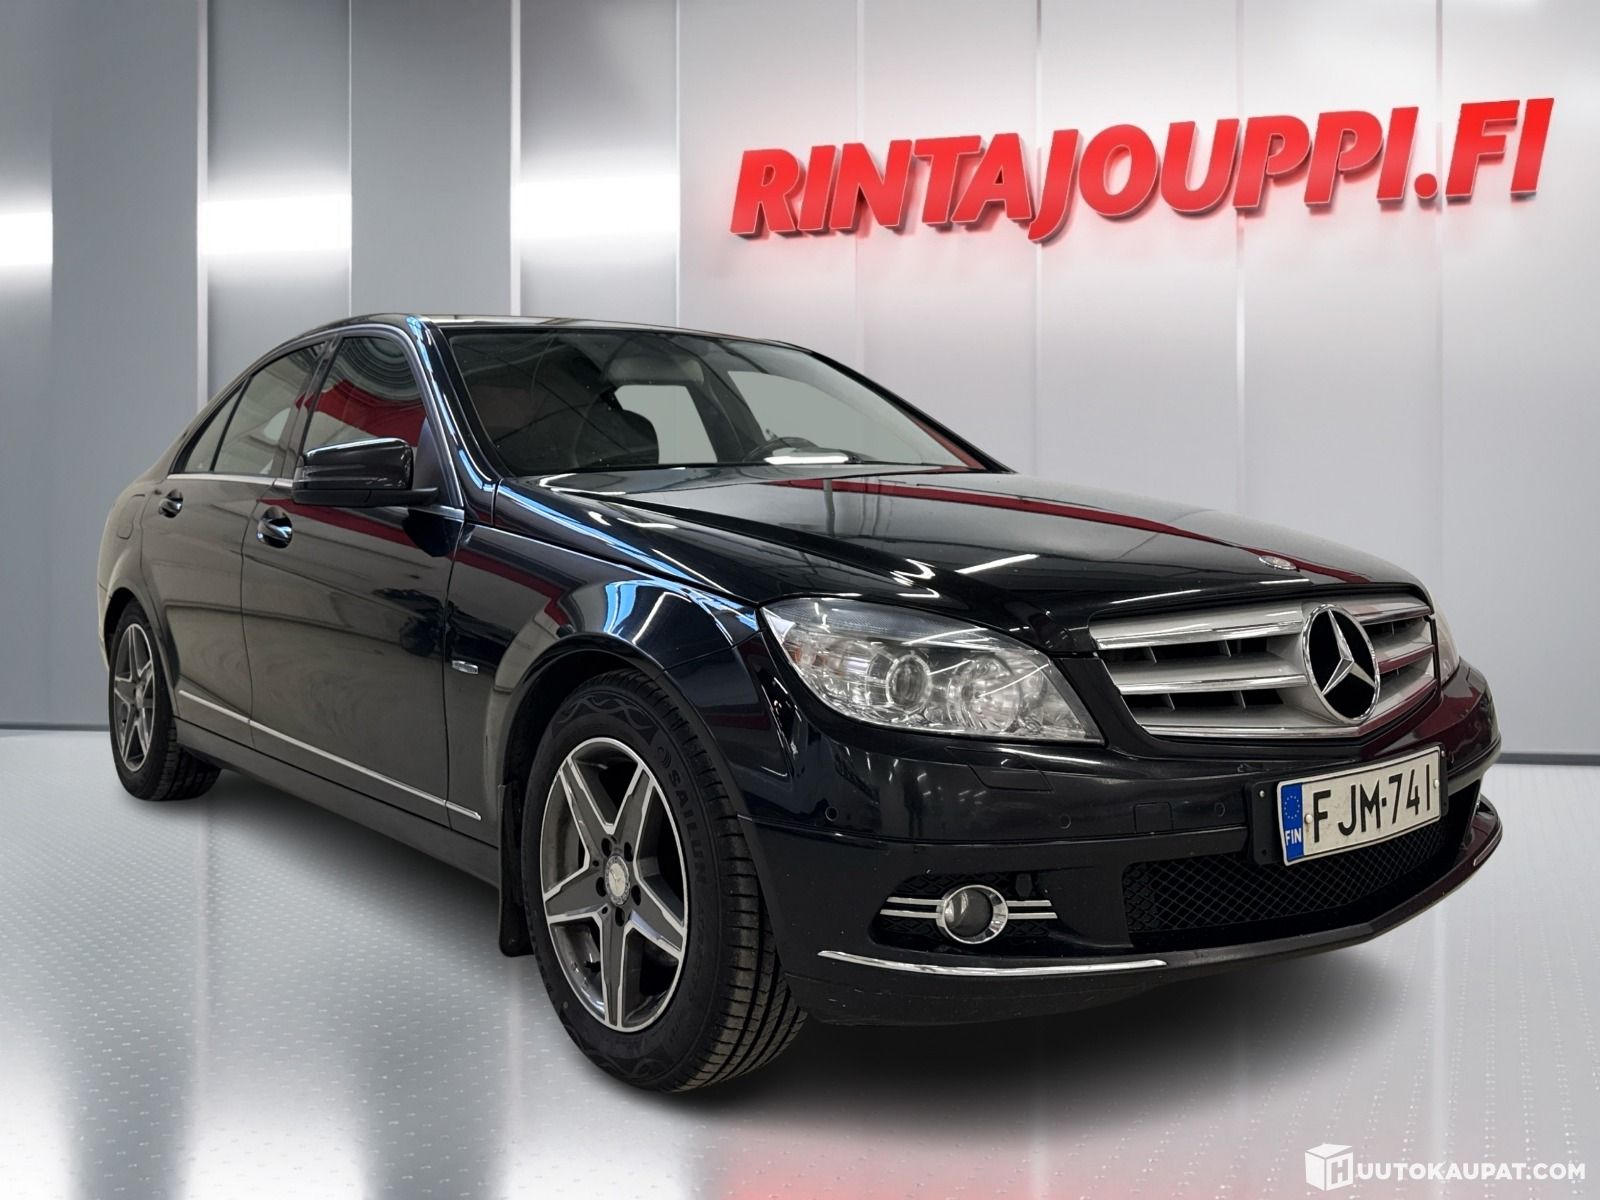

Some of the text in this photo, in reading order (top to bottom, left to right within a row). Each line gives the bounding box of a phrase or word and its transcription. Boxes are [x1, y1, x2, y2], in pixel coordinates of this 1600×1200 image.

[729, 97, 1555, 242] RINTAJOUPPI.FI
[1284, 827, 1302, 846] FIN
[1312, 763, 1431, 843] FJM-741
